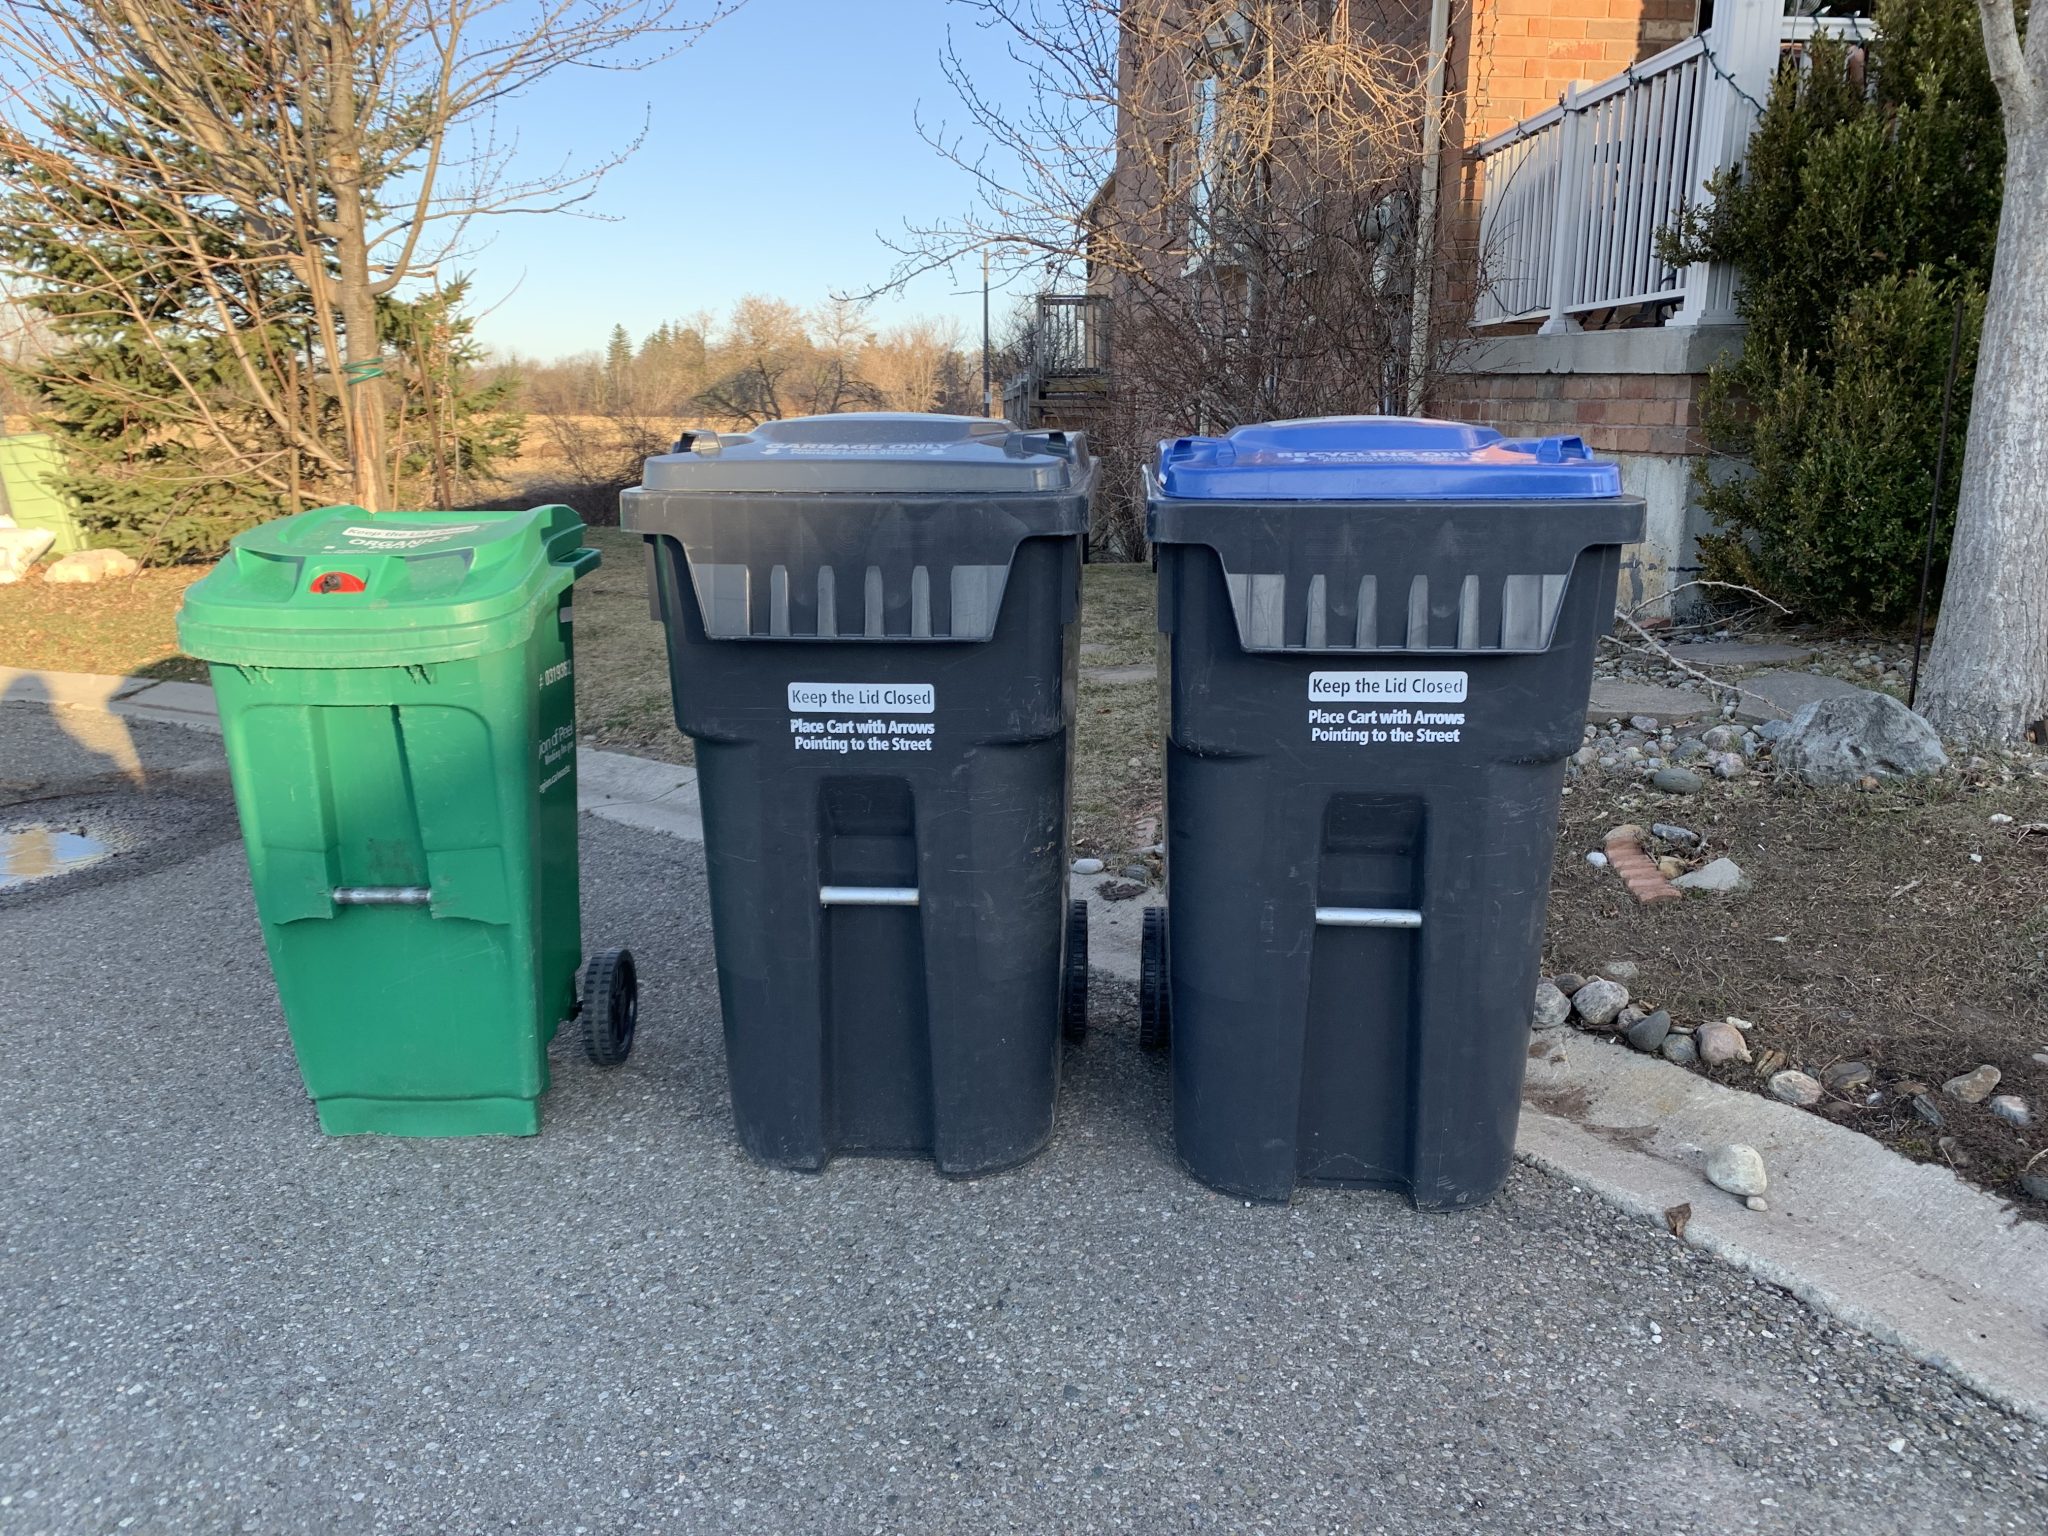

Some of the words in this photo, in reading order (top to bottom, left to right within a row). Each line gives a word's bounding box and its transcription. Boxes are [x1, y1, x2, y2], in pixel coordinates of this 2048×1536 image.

[1312, 678, 1350, 697] Keep
[1355, 678, 1380, 693] the
[1385, 678, 1407, 693] Lid
[1412, 678, 1463, 693] Closed
[792, 690, 827, 707] Keep
[831, 690, 854, 704] the
[859, 690, 879, 704] Lid
[884, 690, 931, 705] Closed
[790, 718, 824, 733] Place
[827, 719, 855, 734] Cart
[856, 719, 886, 734] with
[888, 720, 935, 734] Arrows
[1308, 709, 1344, 724] Place
[1347, 710, 1377, 724] Cart
[1379, 709, 1411, 724] with
[1413, 710, 1465, 725] Arrows
[551, 728, 560, 746] of
[559, 720, 573, 742] Peel
[1311, 727, 1369, 745] Pointing
[1372, 729, 1387, 742] to
[1390, 727, 1414, 742] the
[1416, 728, 1460, 743] Street
[795, 736, 848, 754] Pointing
[850, 738, 864, 750] to
[867, 737, 889, 750] the
[892, 737, 932, 751] Street
